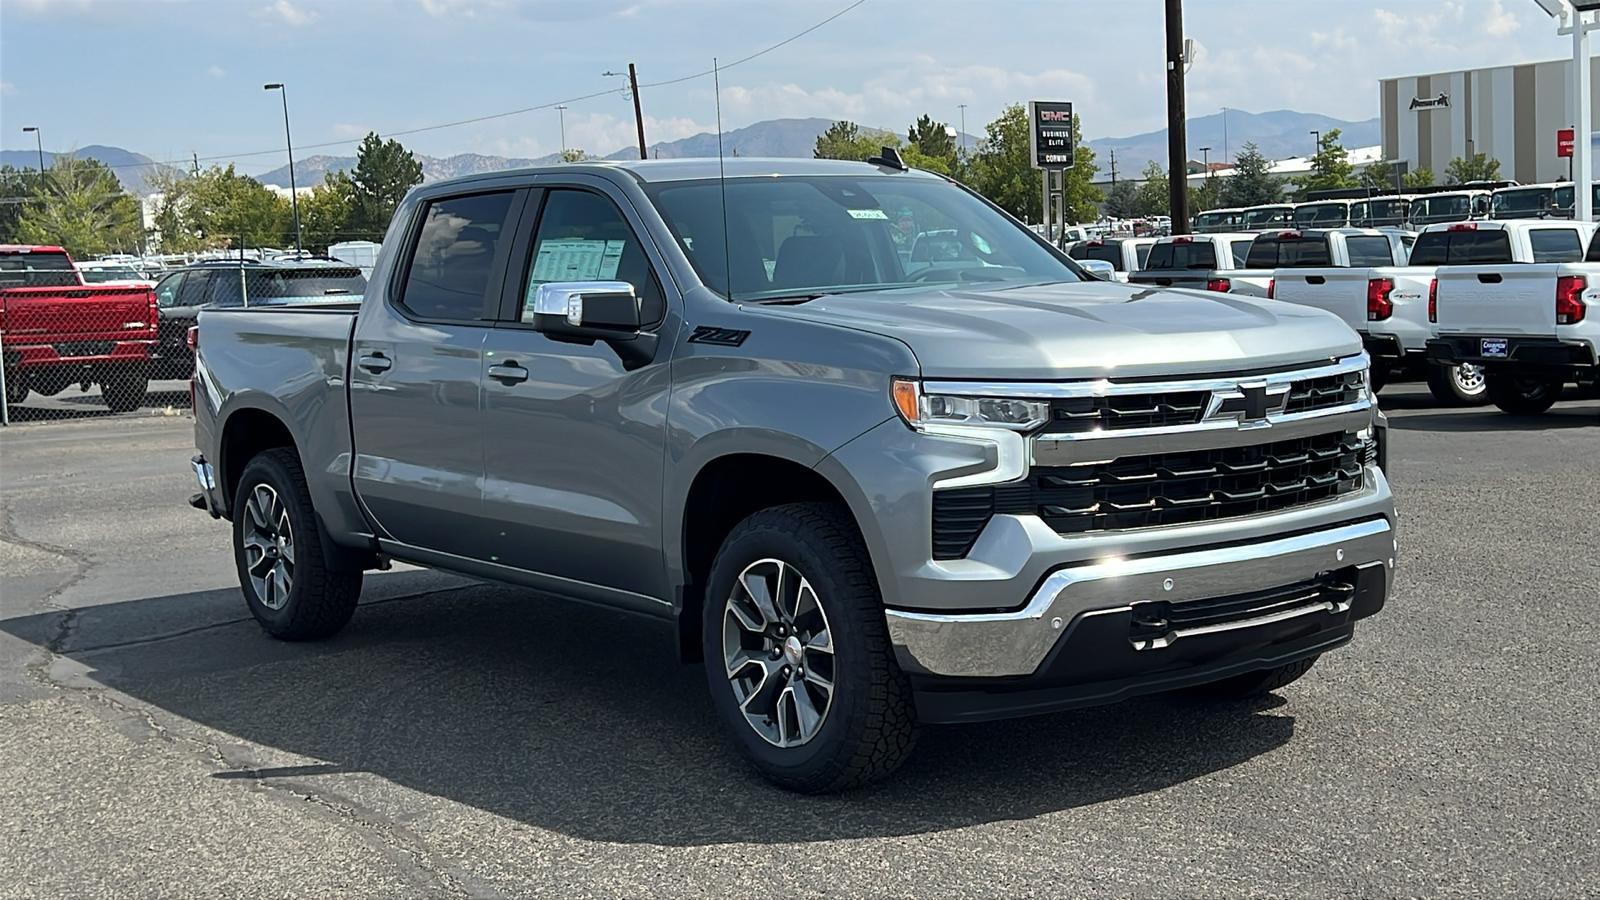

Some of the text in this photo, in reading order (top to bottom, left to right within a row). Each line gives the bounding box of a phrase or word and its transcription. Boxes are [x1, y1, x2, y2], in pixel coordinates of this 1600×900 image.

[1041, 111, 1069, 121] GMC
[1045, 154, 1067, 163] CORWIN
[687, 326, 751, 347] Z71
